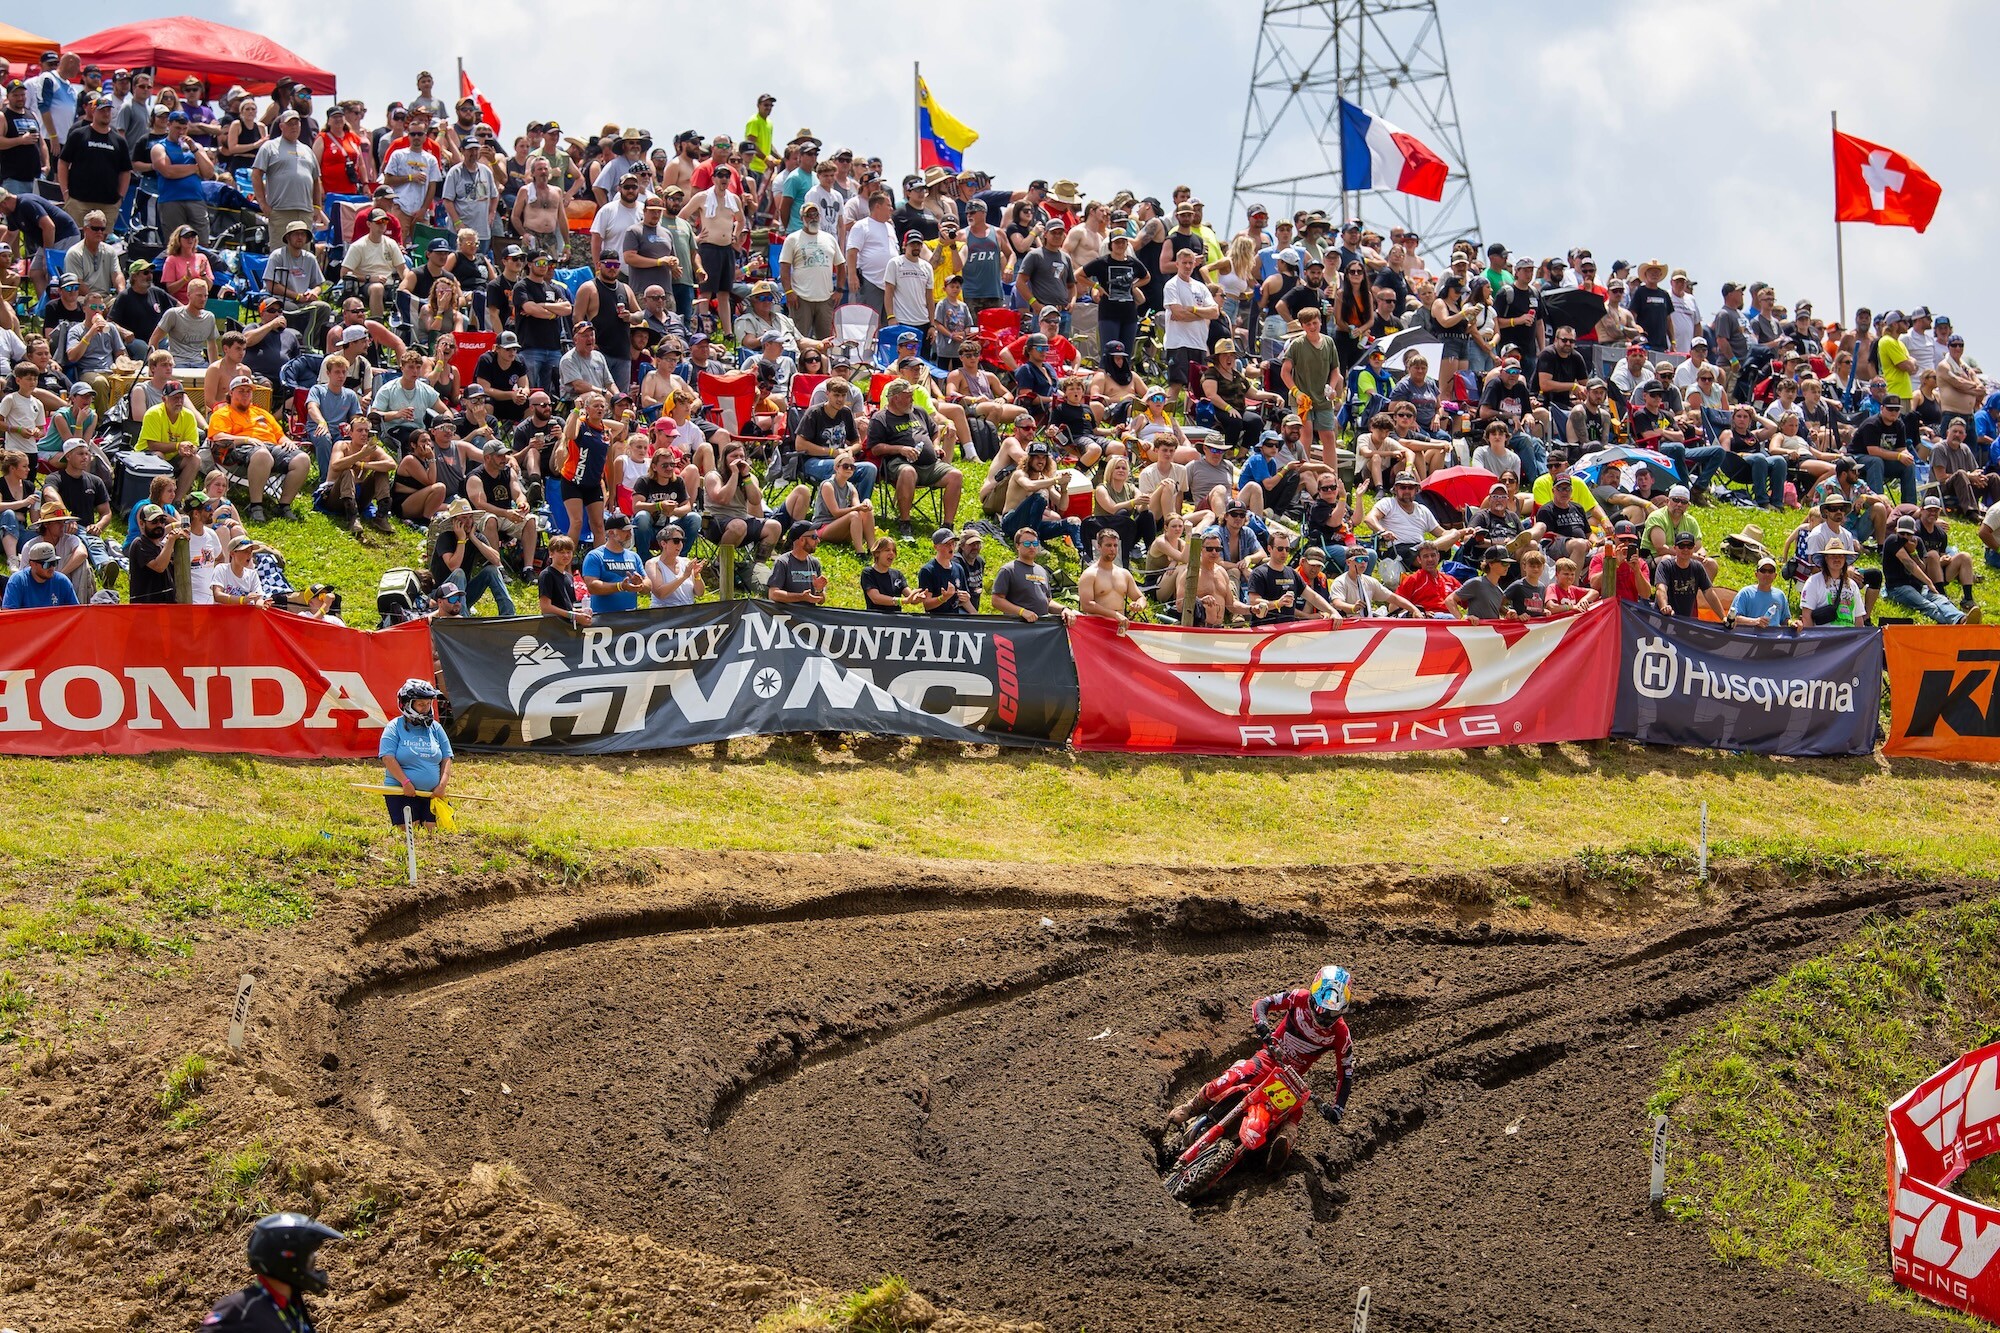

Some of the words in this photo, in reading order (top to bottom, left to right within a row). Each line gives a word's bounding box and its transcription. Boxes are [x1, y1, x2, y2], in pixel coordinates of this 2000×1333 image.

[969, 251, 995, 262] FOX
[572, 446, 589, 485] ACING
[606, 562, 636, 570] YAMAHA
[578, 625, 733, 670] ROCKY
[739, 611, 987, 666] MOUNTAIN
[993, 634, 1019, 733] .com
[1126, 617, 1579, 716] FLY
[1683, 656, 1855, 712] Husqvarna
[1240, 714, 1501, 746] RACING
[1262, 1080, 1298, 1110] 18
[1894, 1188, 2000, 1279] FLY
[1894, 1255, 1968, 1301] ACING
